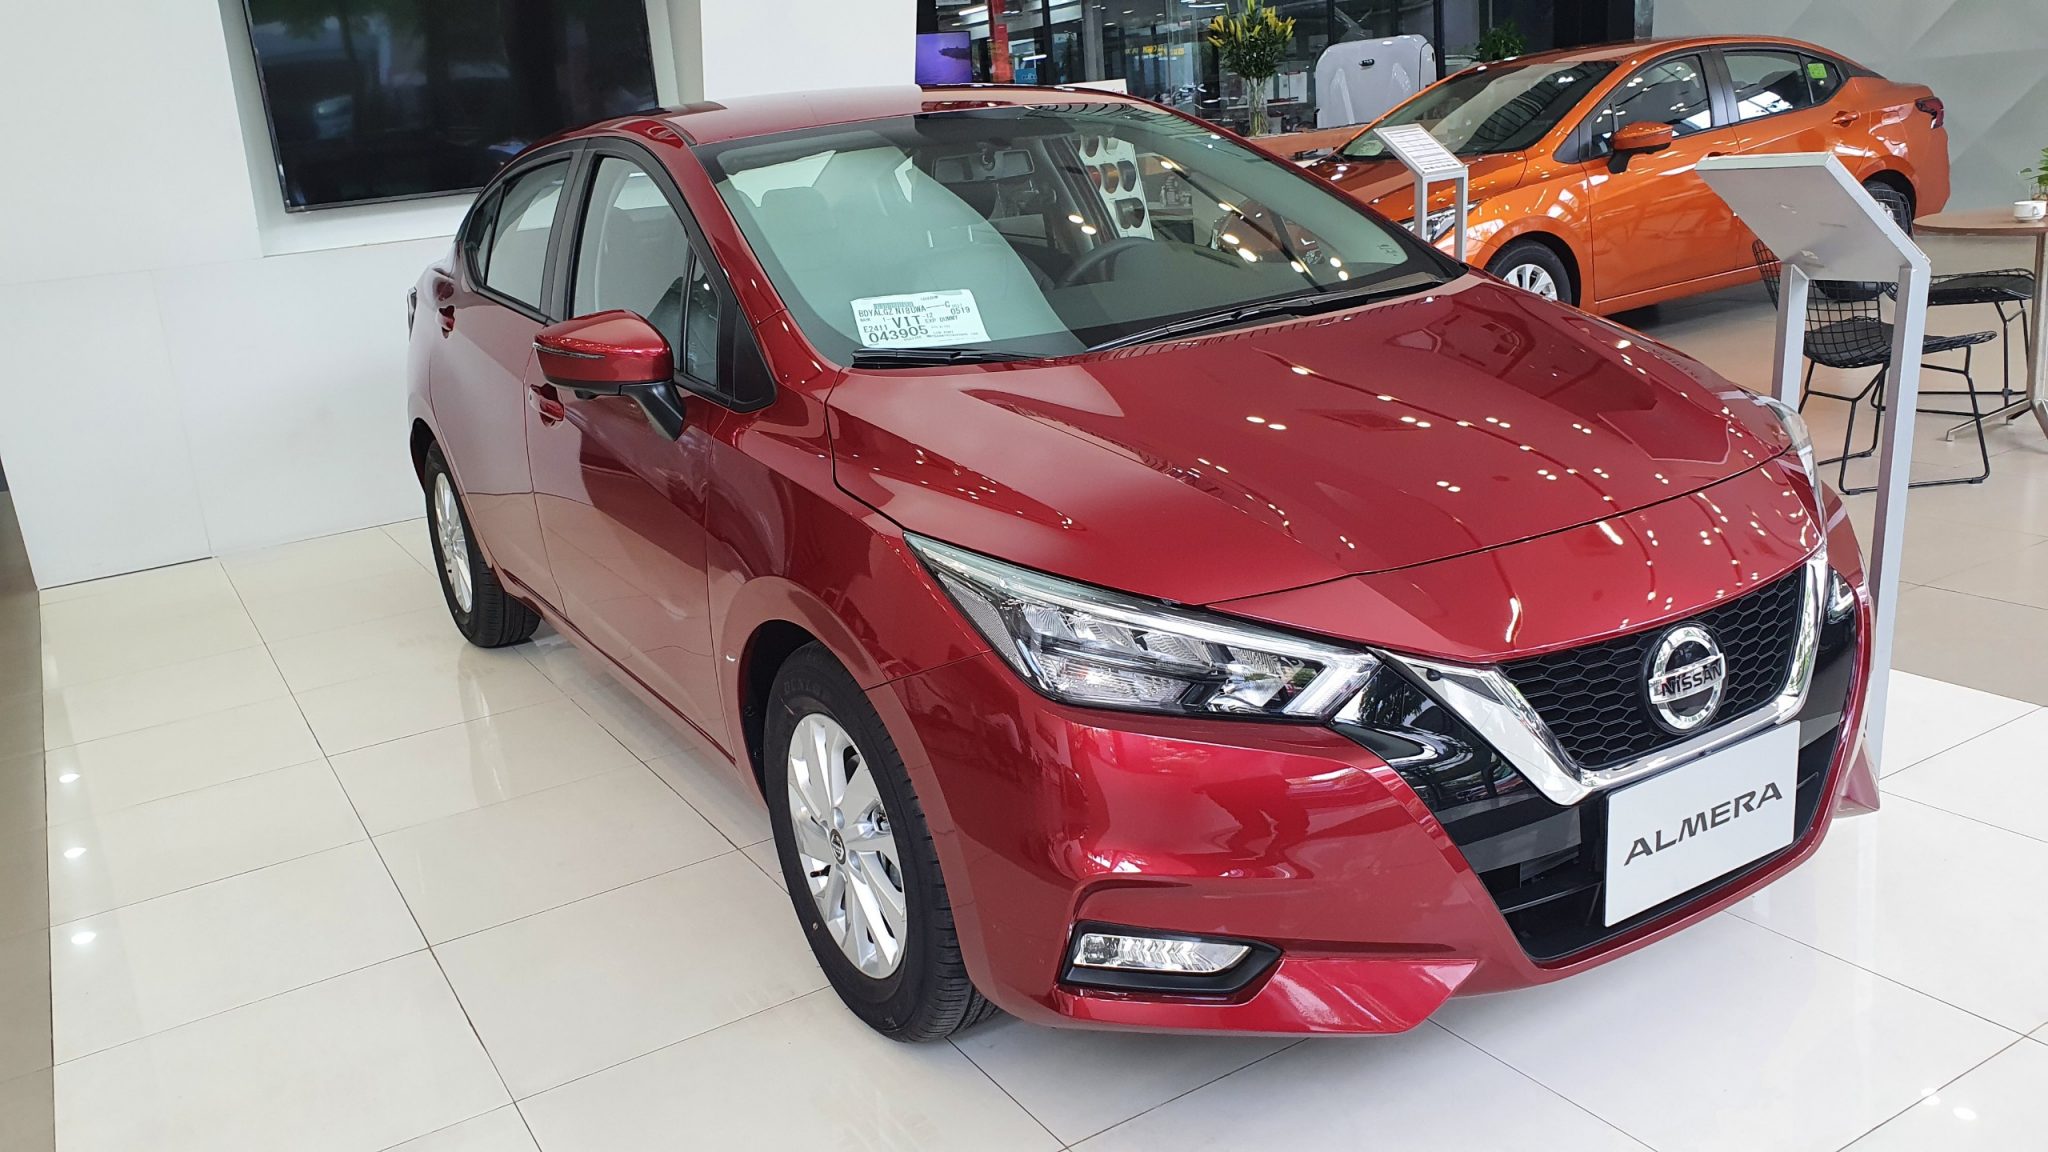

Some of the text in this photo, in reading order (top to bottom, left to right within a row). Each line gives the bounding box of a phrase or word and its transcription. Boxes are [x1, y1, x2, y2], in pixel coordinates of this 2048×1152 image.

[950, 306, 971, 315] 0519
[891, 315, 921, 328] VIT
[868, 325, 928, 343] 043905
[1660, 662, 1722, 696] NISSAN
[1624, 782, 1783, 866] ALMERA
